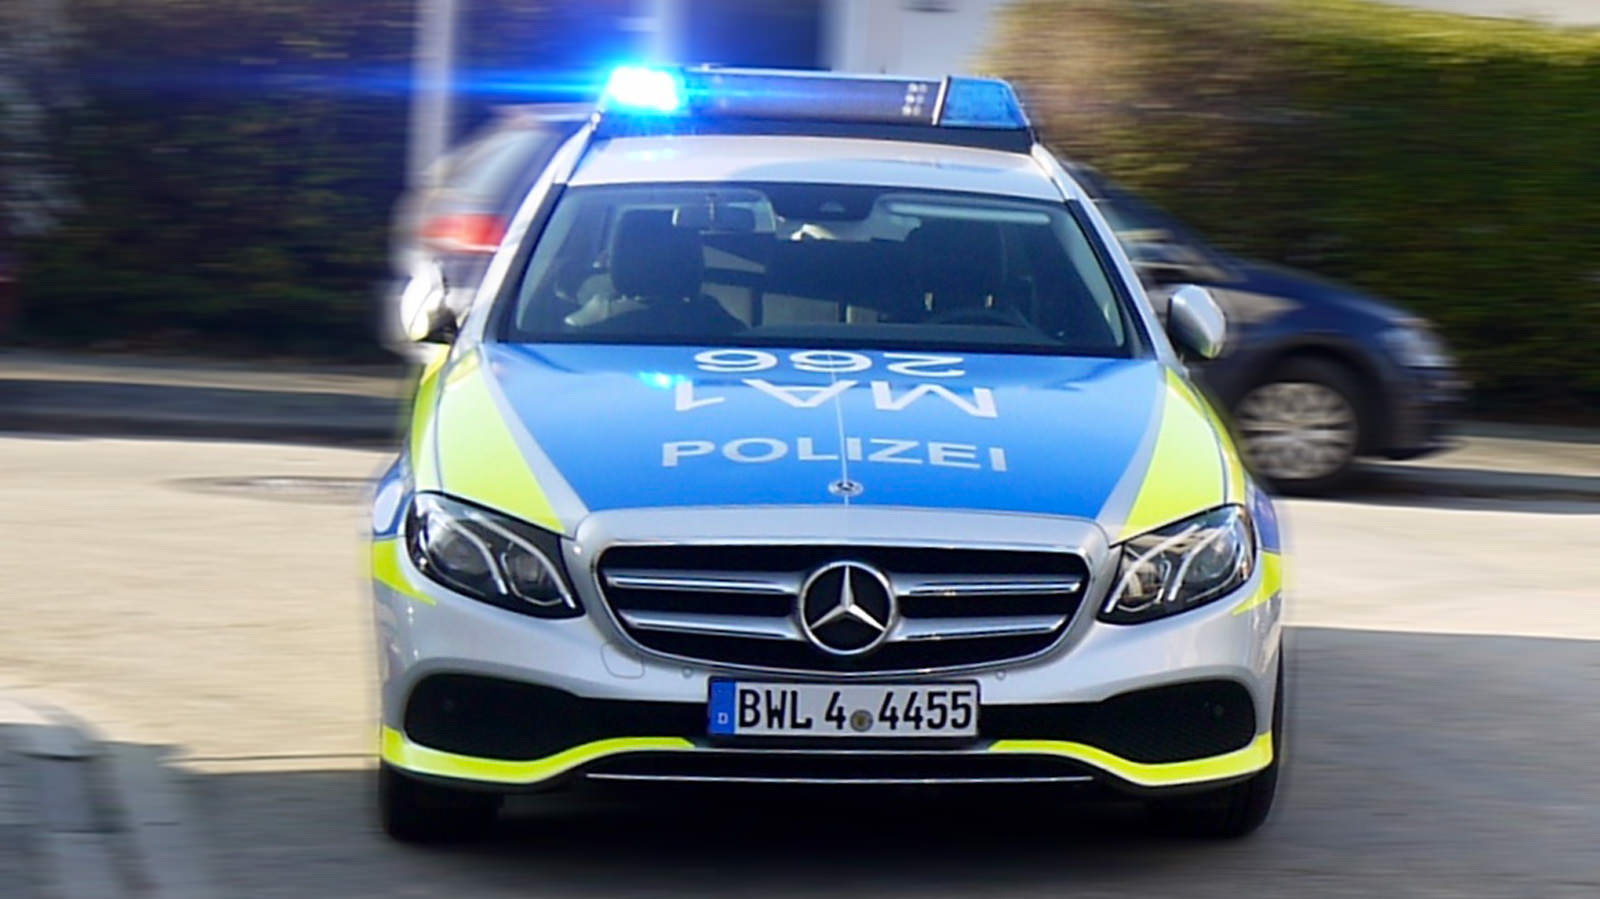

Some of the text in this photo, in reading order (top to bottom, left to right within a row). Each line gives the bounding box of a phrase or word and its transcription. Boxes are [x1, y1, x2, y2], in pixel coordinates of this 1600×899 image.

[694, 349, 966, 377] 266
[662, 437, 1007, 471] POLIZEI
[717, 714, 729, 725] D
[738, 688, 972, 731] BWL 4 4455
